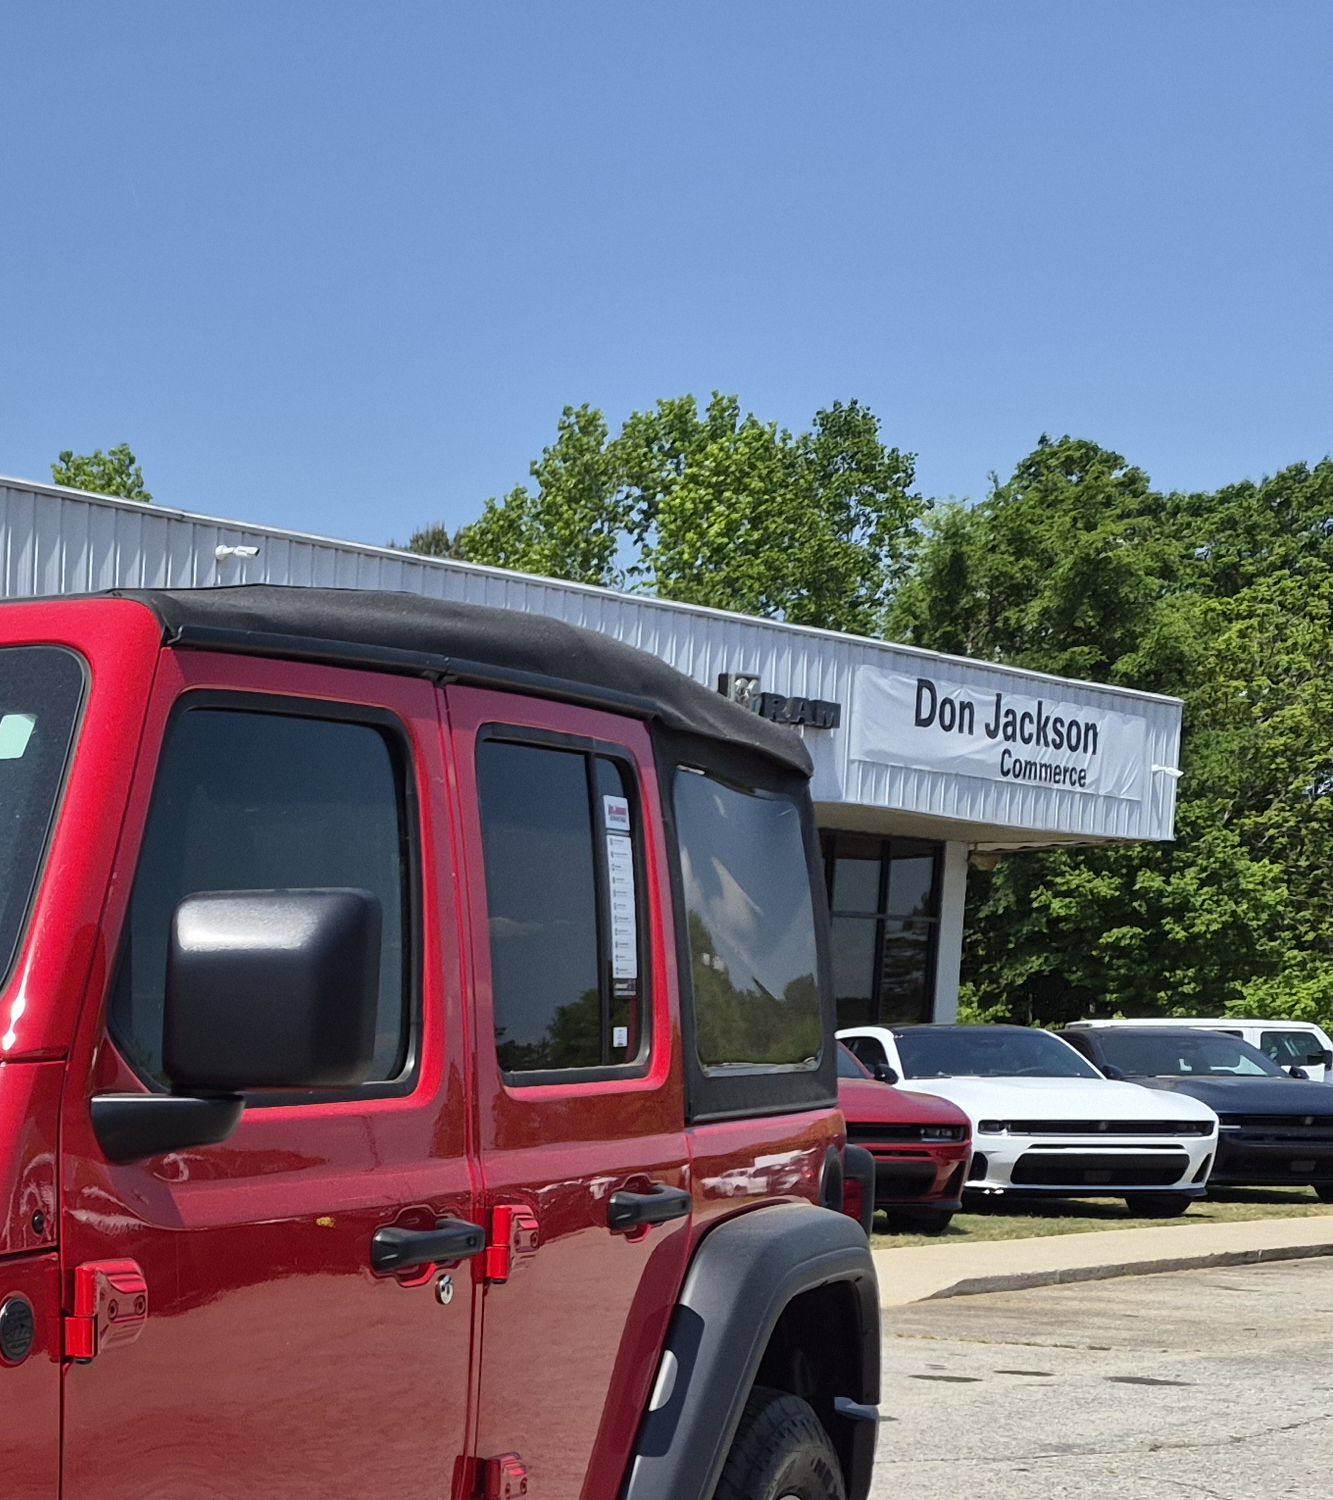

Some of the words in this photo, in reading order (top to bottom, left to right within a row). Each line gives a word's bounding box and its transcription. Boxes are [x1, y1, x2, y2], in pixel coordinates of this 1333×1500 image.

[759, 692, 841, 729] RAM
[914, 678, 975, 735] Don
[984, 692, 1099, 755] Jackson
[1000, 748, 1087, 788] Commerce
